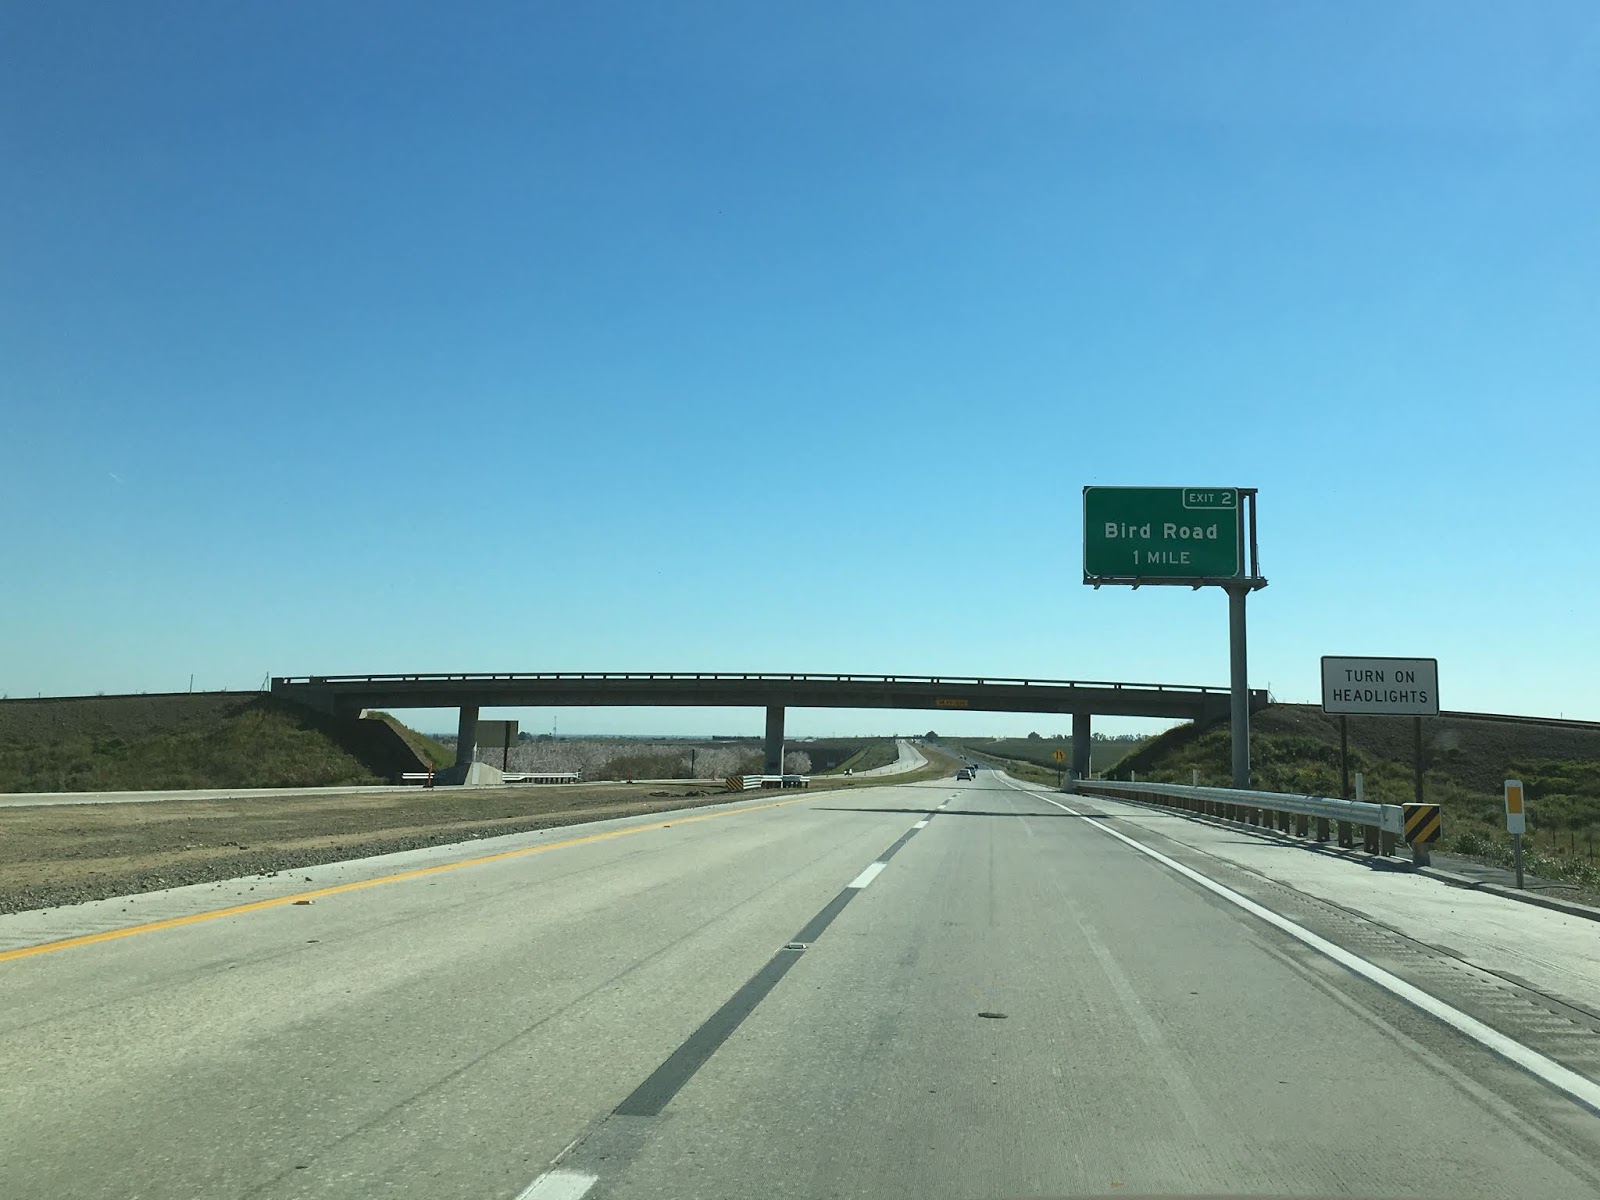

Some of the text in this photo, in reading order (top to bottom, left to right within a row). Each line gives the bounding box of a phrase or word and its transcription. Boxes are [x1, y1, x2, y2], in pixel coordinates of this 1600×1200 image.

[1189, 491, 1232, 504] EXIT 2
[1105, 522, 1218, 539] Bird Road
[1132, 549, 1190, 565] 1 MILE
[1345, 669, 1415, 683] TURN ON
[1333, 689, 1428, 704] HEADLIGHTS
